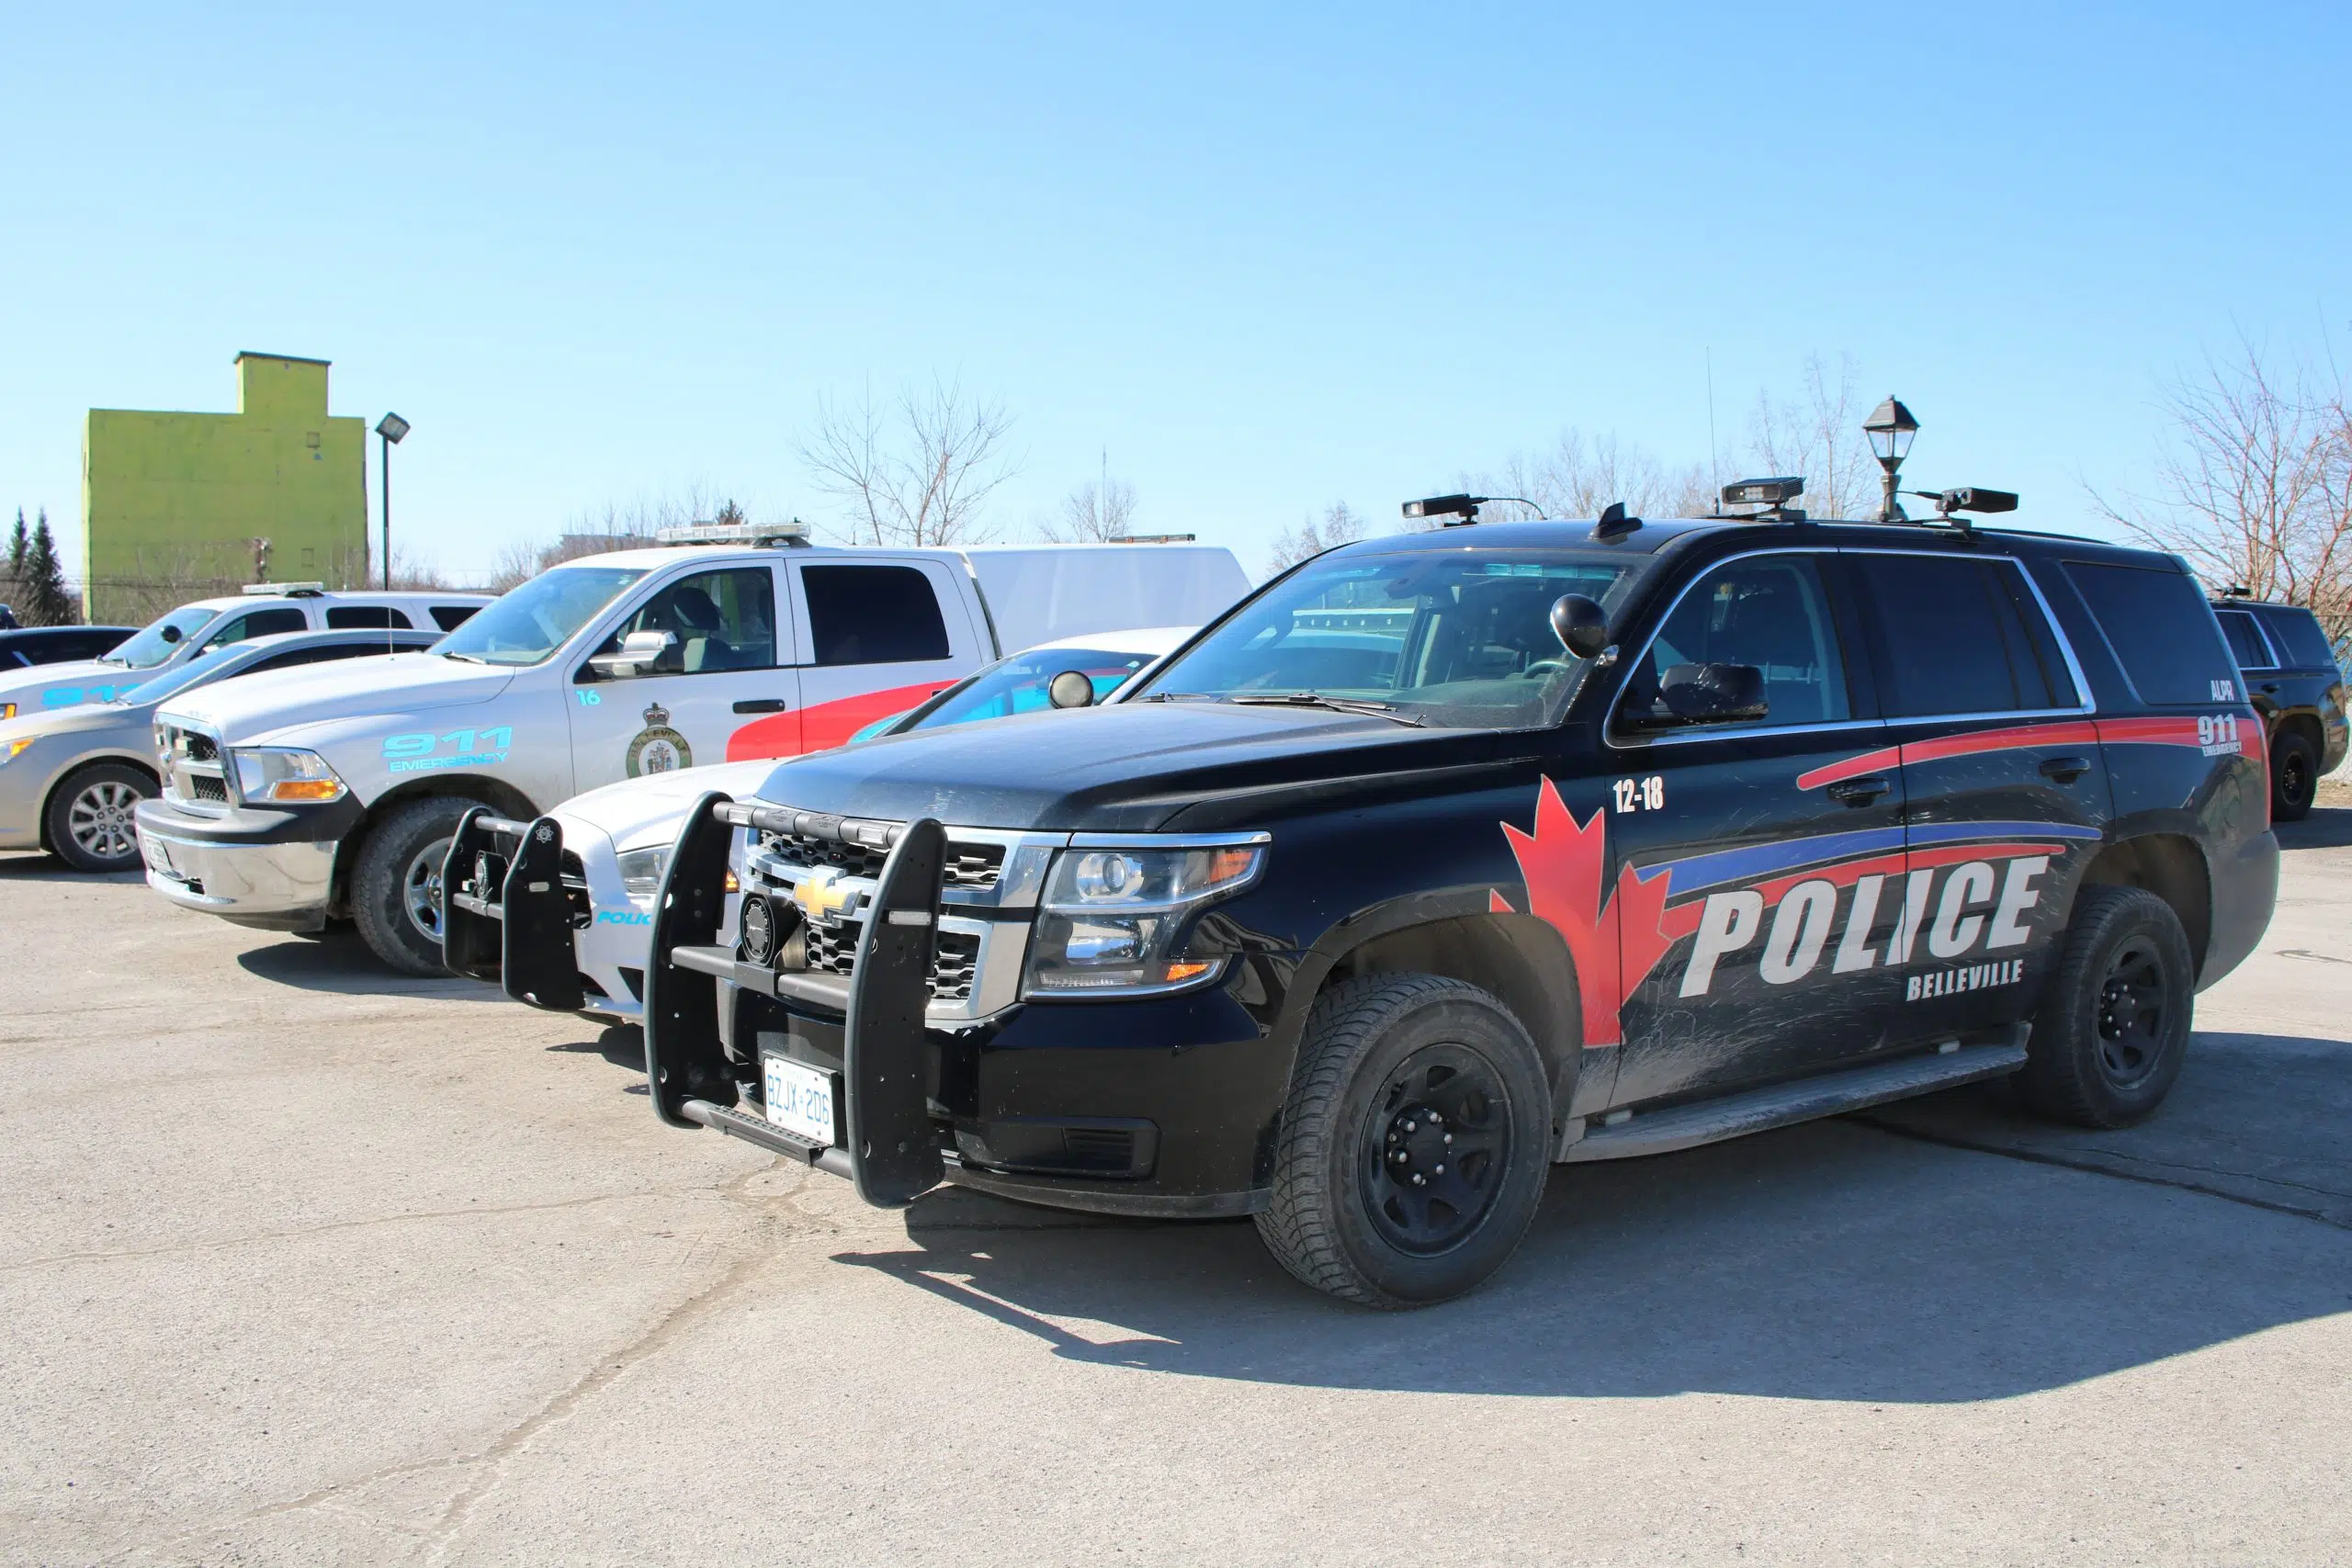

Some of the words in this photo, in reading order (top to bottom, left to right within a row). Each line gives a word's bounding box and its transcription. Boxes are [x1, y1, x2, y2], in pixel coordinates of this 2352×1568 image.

[576, 690, 601, 706] 16
[2211, 680, 2234, 701] ALPR
[382, 726, 513, 758] 911
[2197, 713, 2238, 745] 911
[389, 752, 508, 773] EMERGENCY
[2201, 741, 2243, 757] EMERGENCY
[1613, 776, 1664, 814] 12-18
[596, 910, 653, 925] POLIC
[1679, 855, 2050, 998] POLICE
[1906, 959, 2024, 1001] BELLEVILLE
[766, 1074, 797, 1115] BZJX
